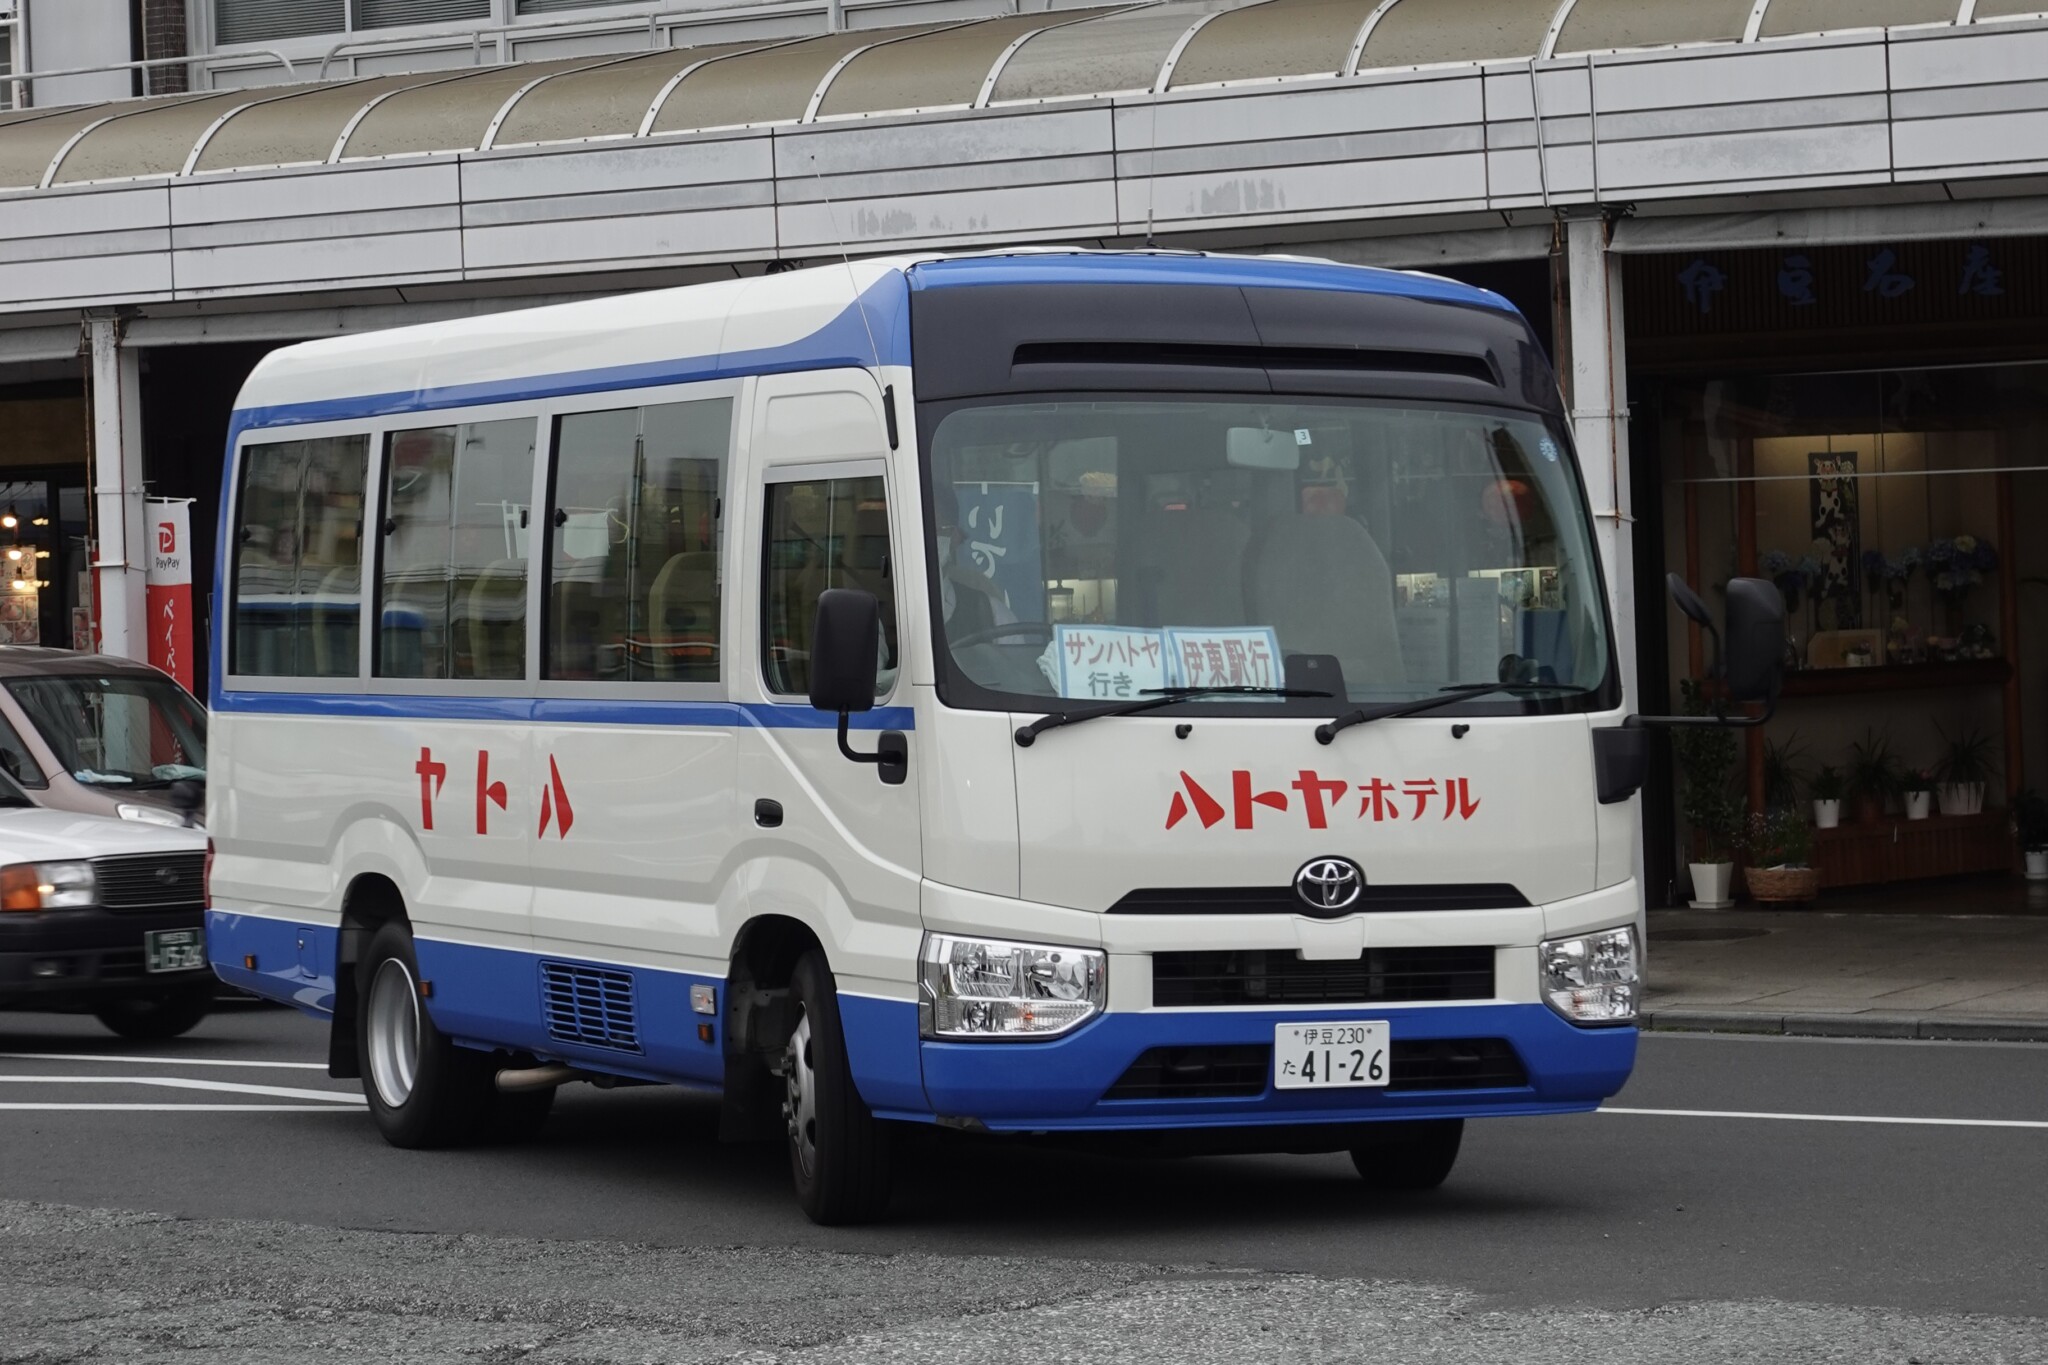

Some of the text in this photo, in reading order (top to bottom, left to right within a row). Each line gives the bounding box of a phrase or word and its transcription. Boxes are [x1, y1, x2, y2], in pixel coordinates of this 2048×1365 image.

[156, 557, 180, 570] PayPay
[1065, 633, 1160, 669] サンハトヤ
[1088, 671, 1133, 697] 行き
[1301, 1048, 1383, 1083] 41-26
